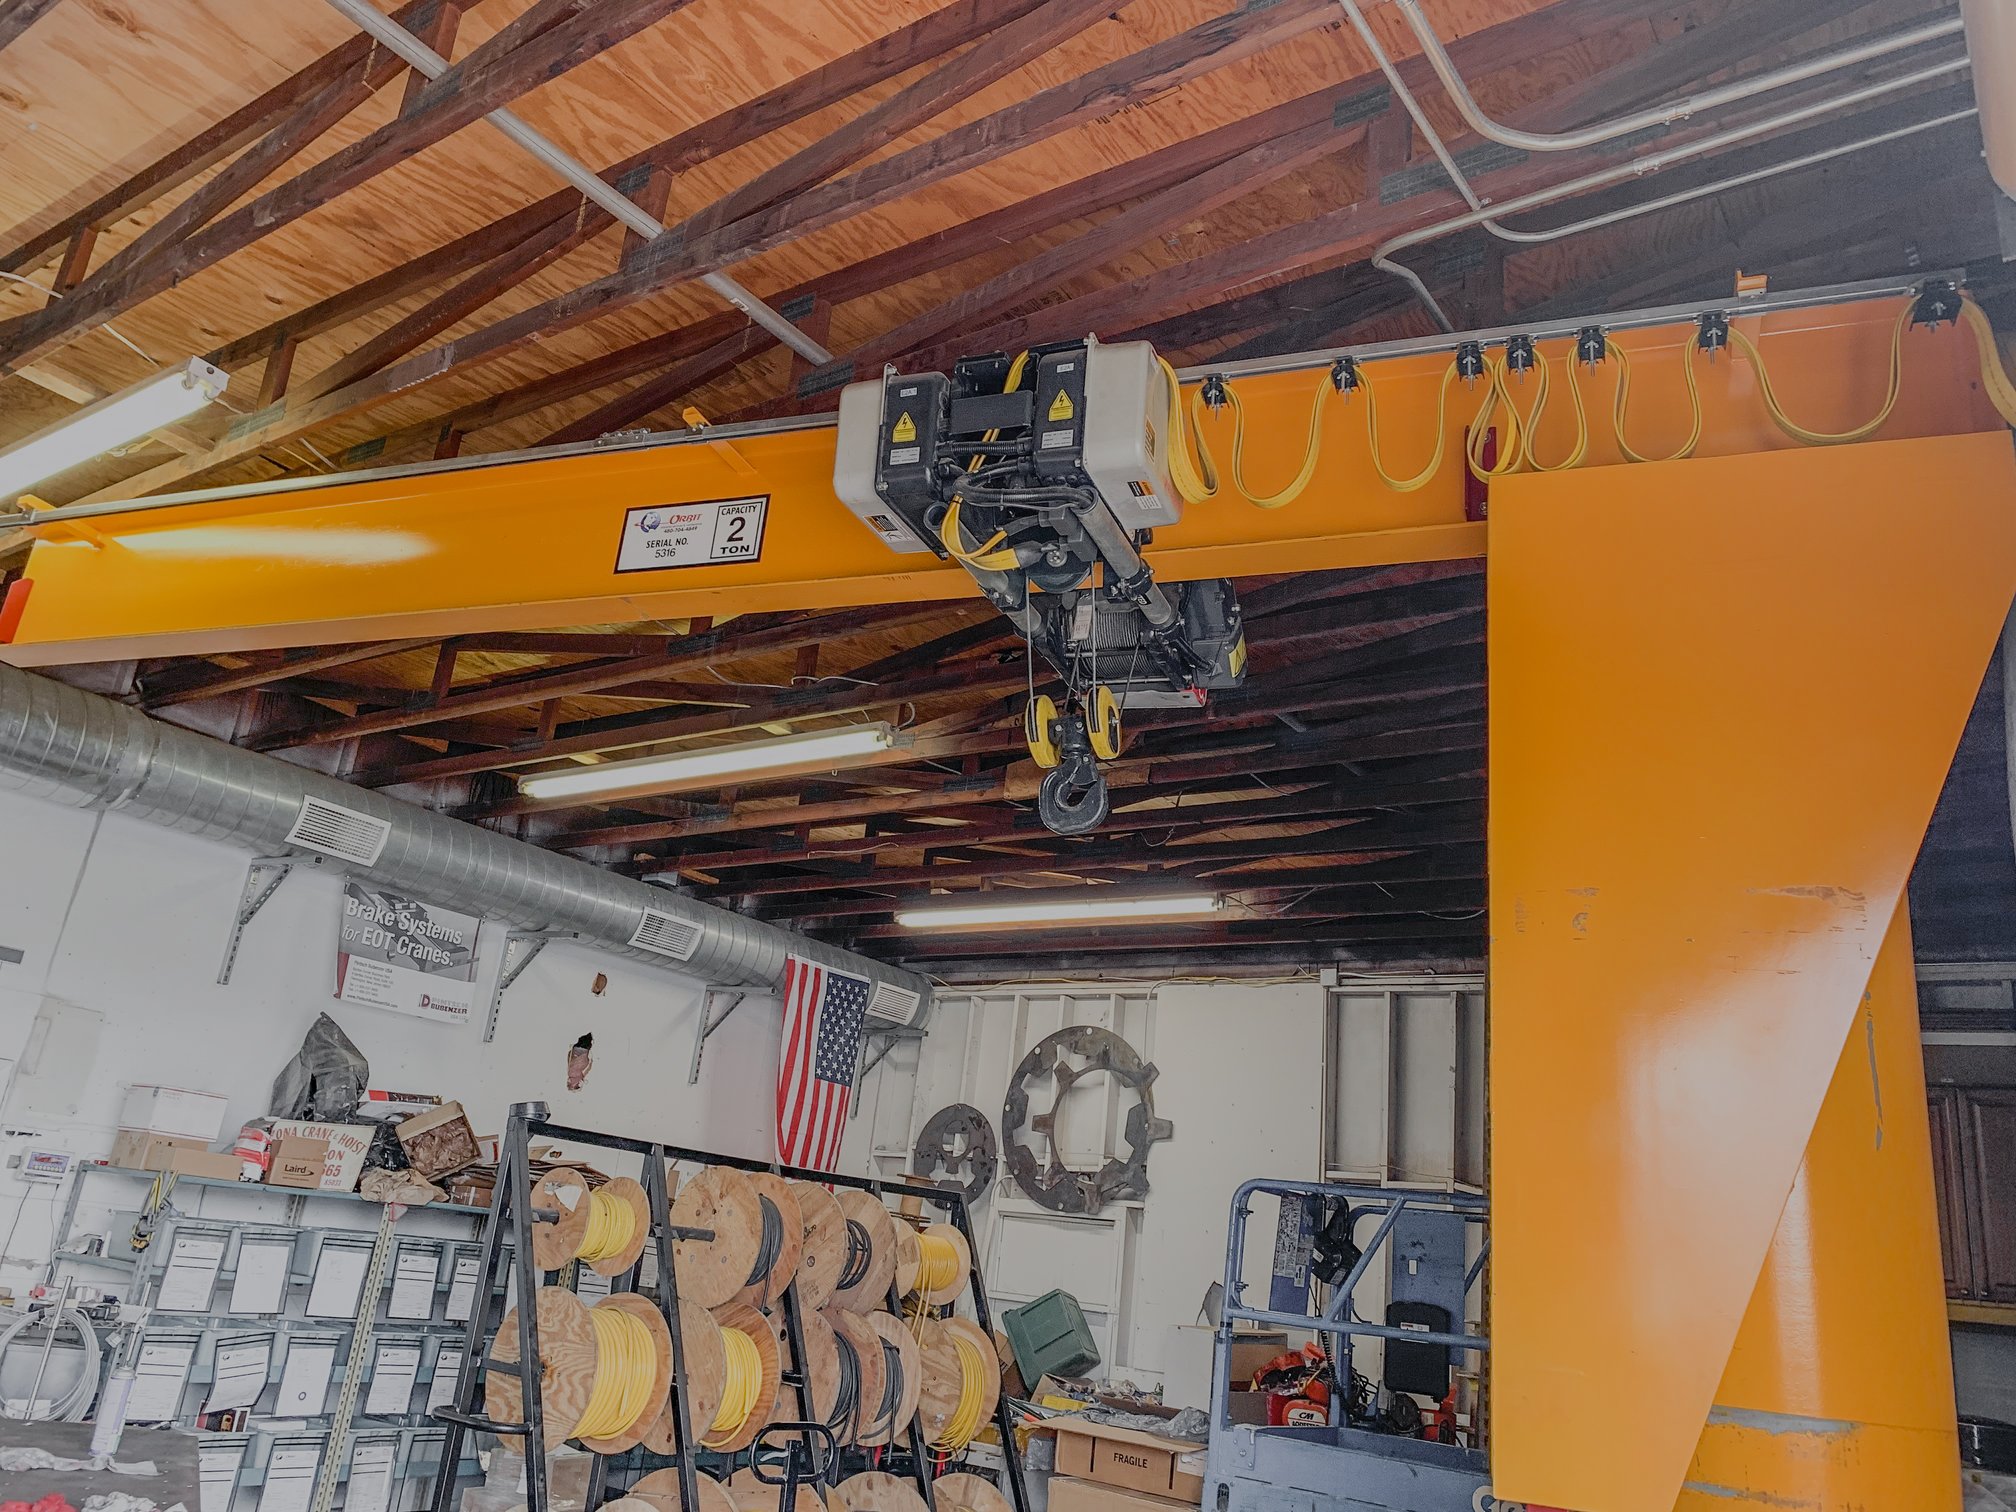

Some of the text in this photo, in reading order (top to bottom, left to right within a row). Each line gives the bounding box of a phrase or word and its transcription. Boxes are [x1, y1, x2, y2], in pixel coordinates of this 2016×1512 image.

[721, 505, 757, 516] CAPACITY
[726, 516, 746, 543] 2
[646, 537, 689, 549] SERIAL NO.
[655, 547, 677, 559] 5316
[720, 544, 750, 555] TON
[346, 897, 463, 945] Brake Systems
[341, 924, 455, 967] for EOT Cranes.
[302, 1126, 335, 1141] CRANE
[338, 1133, 368, 1156] HOIST
[284, 1164, 307, 1174] Laird
[1298, 1412, 1315, 1420] CM
[1113, 1452, 1149, 1469] FRAGILE
